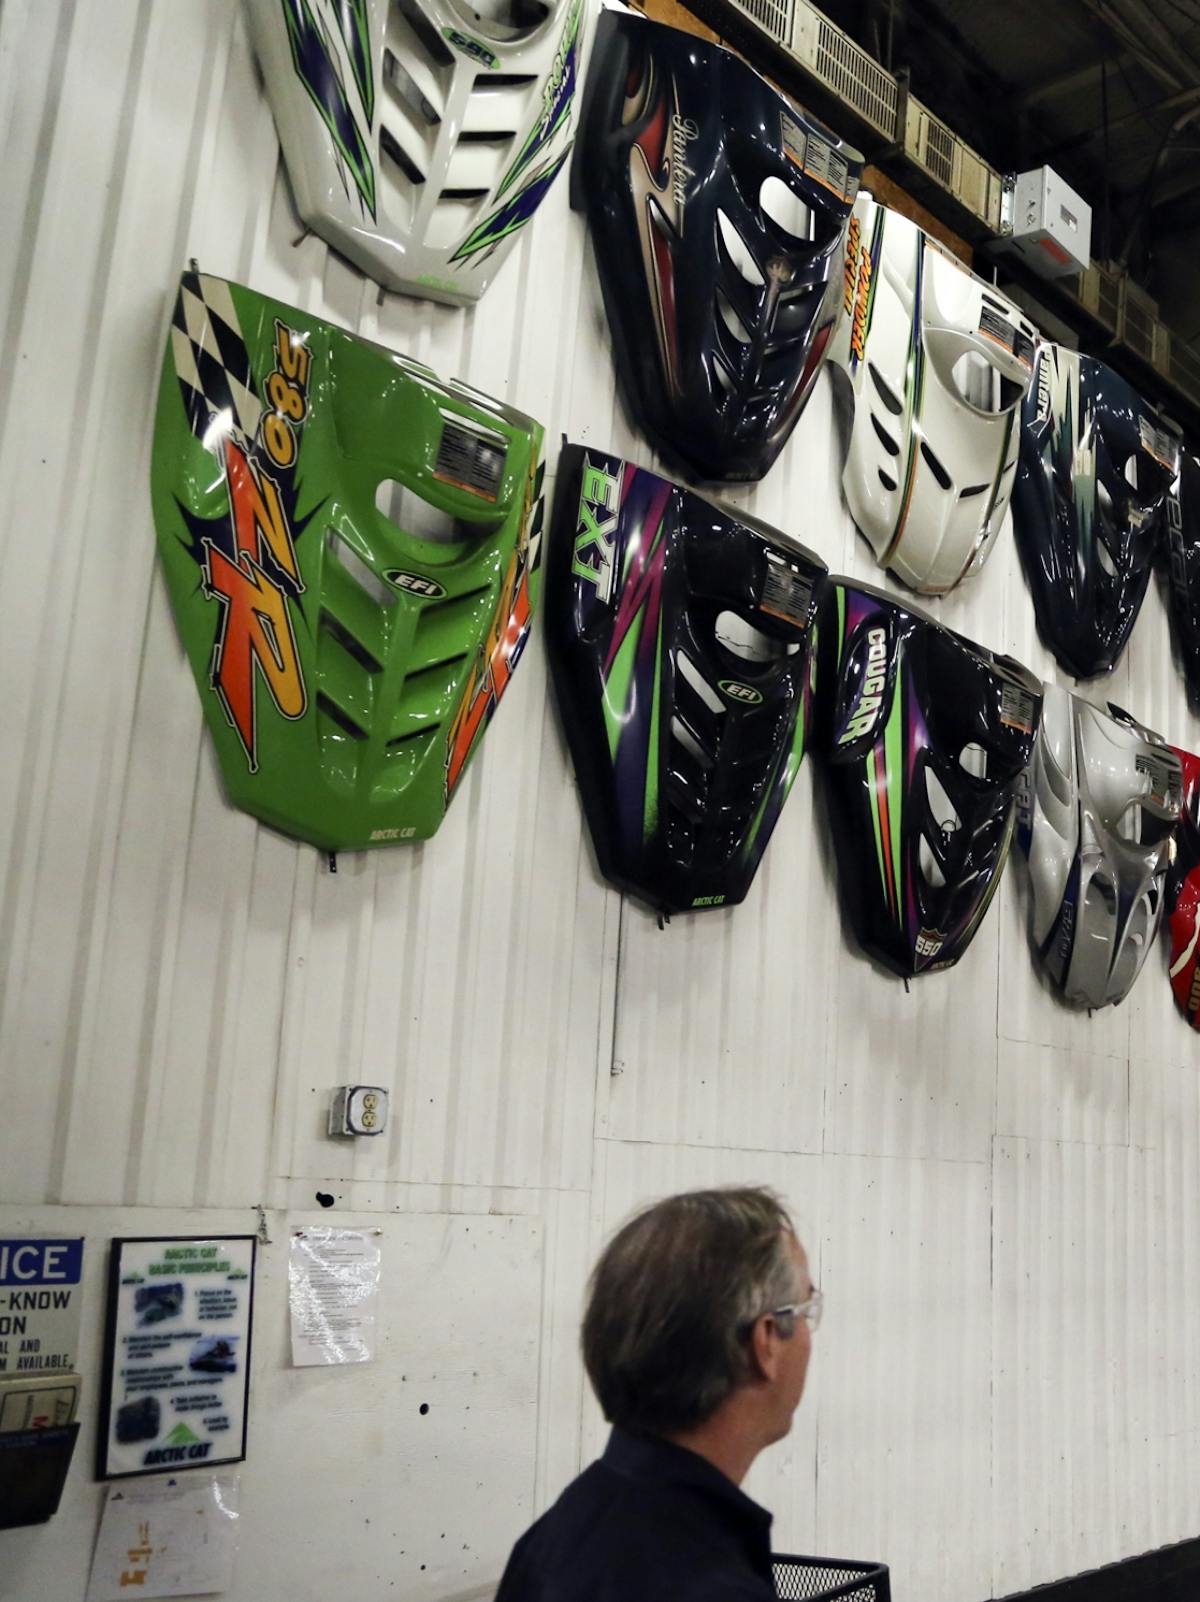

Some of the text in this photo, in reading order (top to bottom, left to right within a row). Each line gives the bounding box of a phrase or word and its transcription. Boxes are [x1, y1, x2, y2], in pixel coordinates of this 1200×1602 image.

[672, 114, 699, 205] Pantera
[844, 213, 860, 317] SPECIAL
[850, 246, 872, 361] POWDER
[261, 319, 311, 468] 580
[571, 451, 625, 605] EXT
[394, 574, 437, 595] EFI
[727, 684, 756, 700] EFI
[838, 628, 887, 744] COUGAR
[915, 934, 943, 956] 550
[20, 1339, 41, 1353] AND
[143, 1442, 213, 1465] ARCTIC CAT
